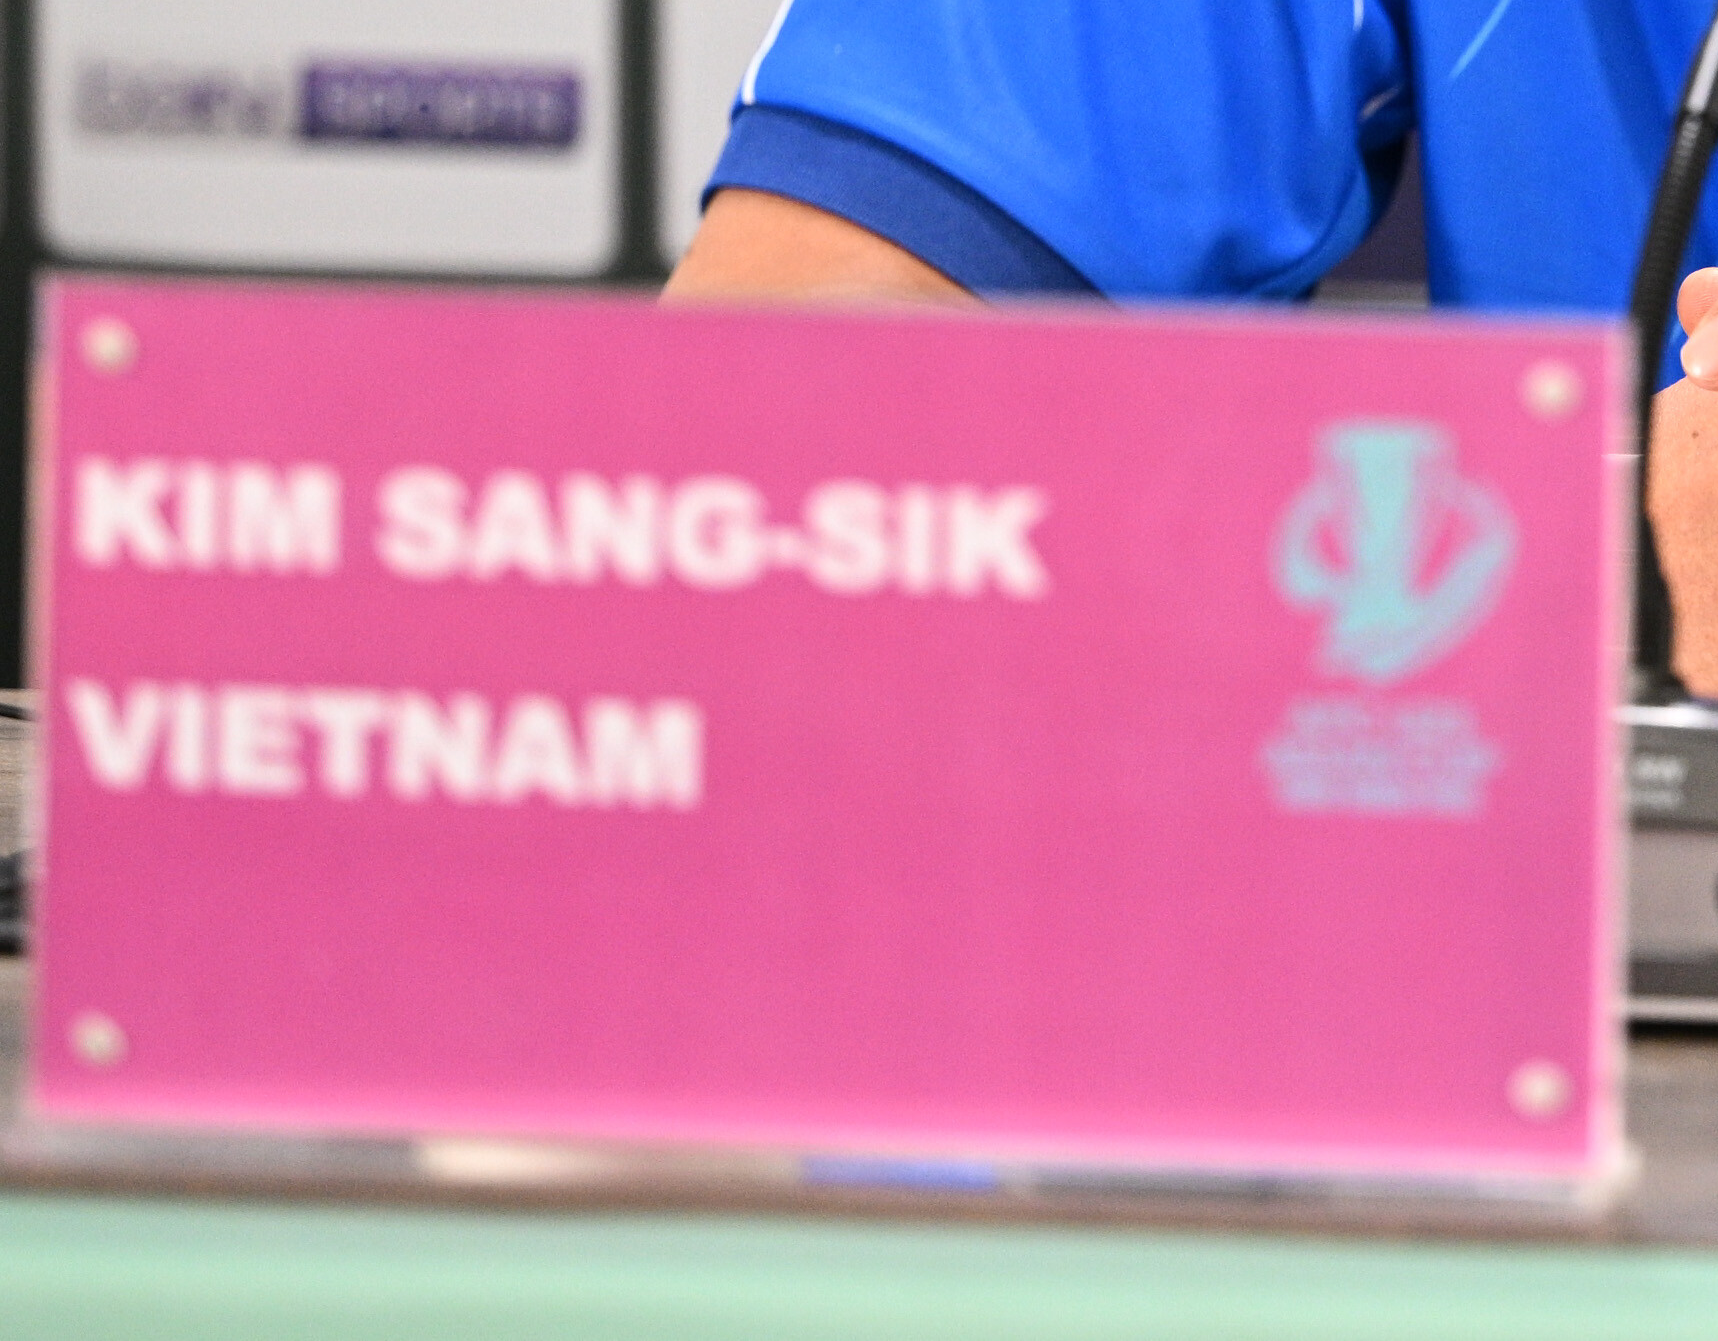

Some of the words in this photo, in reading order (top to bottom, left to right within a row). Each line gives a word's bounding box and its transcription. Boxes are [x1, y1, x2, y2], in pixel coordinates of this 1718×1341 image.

[75, 457, 345, 576] KIM
[377, 465, 1050, 600] SANG-SIK
[66, 678, 706, 810] VIETNAM
